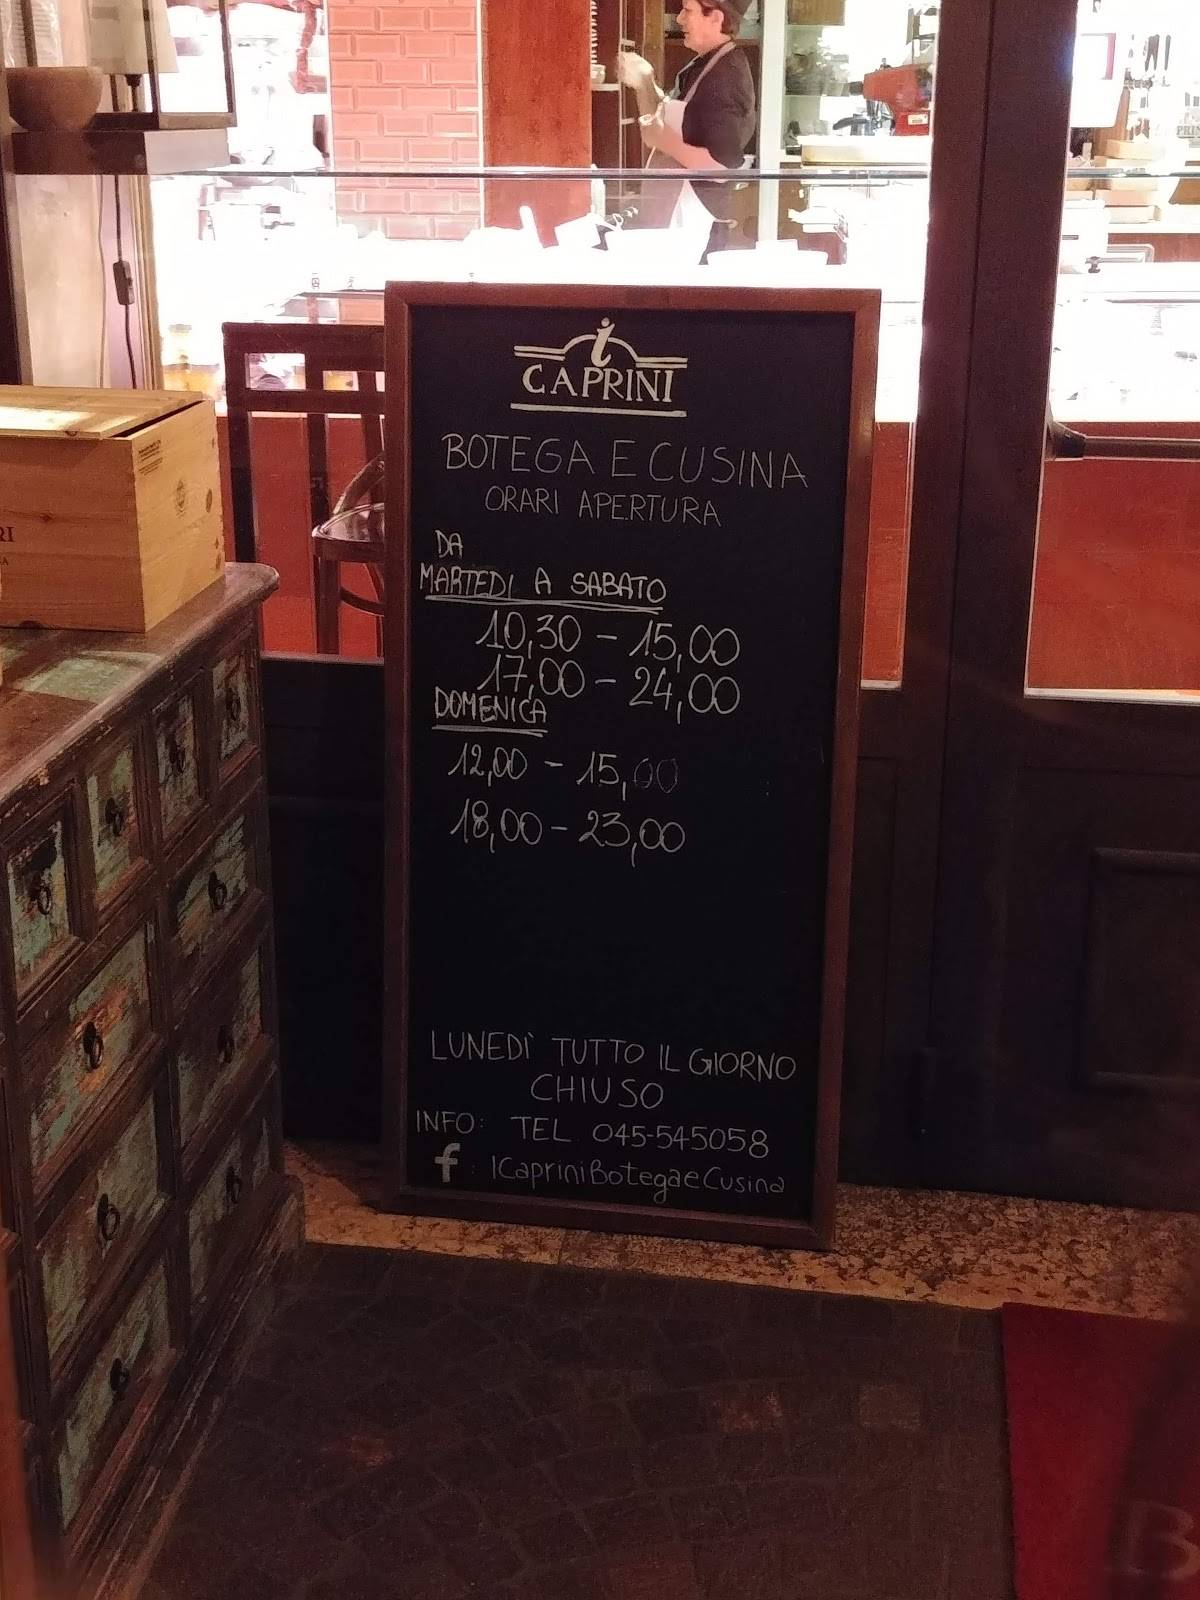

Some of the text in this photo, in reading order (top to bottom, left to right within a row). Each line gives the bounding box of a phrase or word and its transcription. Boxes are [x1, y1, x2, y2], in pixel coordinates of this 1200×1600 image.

[521, 363, 673, 403] CAPRINI
[441, 433, 808, 488] BOTEGA E CUSINA
[485, 485, 722, 527] ORARI APERTURA
[436, 530, 464, 558] DA
[534, 567, 552, 595] A
[571, 571, 667, 603] SABATO
[476, 610, 581, 661] 10,30
[629, 620, 740, 672] 15,00
[434, 686, 547, 723] DOMENICA
[477, 654, 585, 699] 17,00
[629, 666, 741, 724] 24,00
[448, 743, 528, 786] 12,00
[577, 752, 679, 801] 15,00
[450, 798, 543, 854] 18,00
[579, 810, 685, 867] 23,00
[431, 1030, 796, 1083] LUNEDÌ TUTTO IL GIORNO
[530, 1073, 664, 1110] CHIUSO
[416, 1109, 485, 1135] INFO:
[592, 1122, 769, 1159] 045-545058
